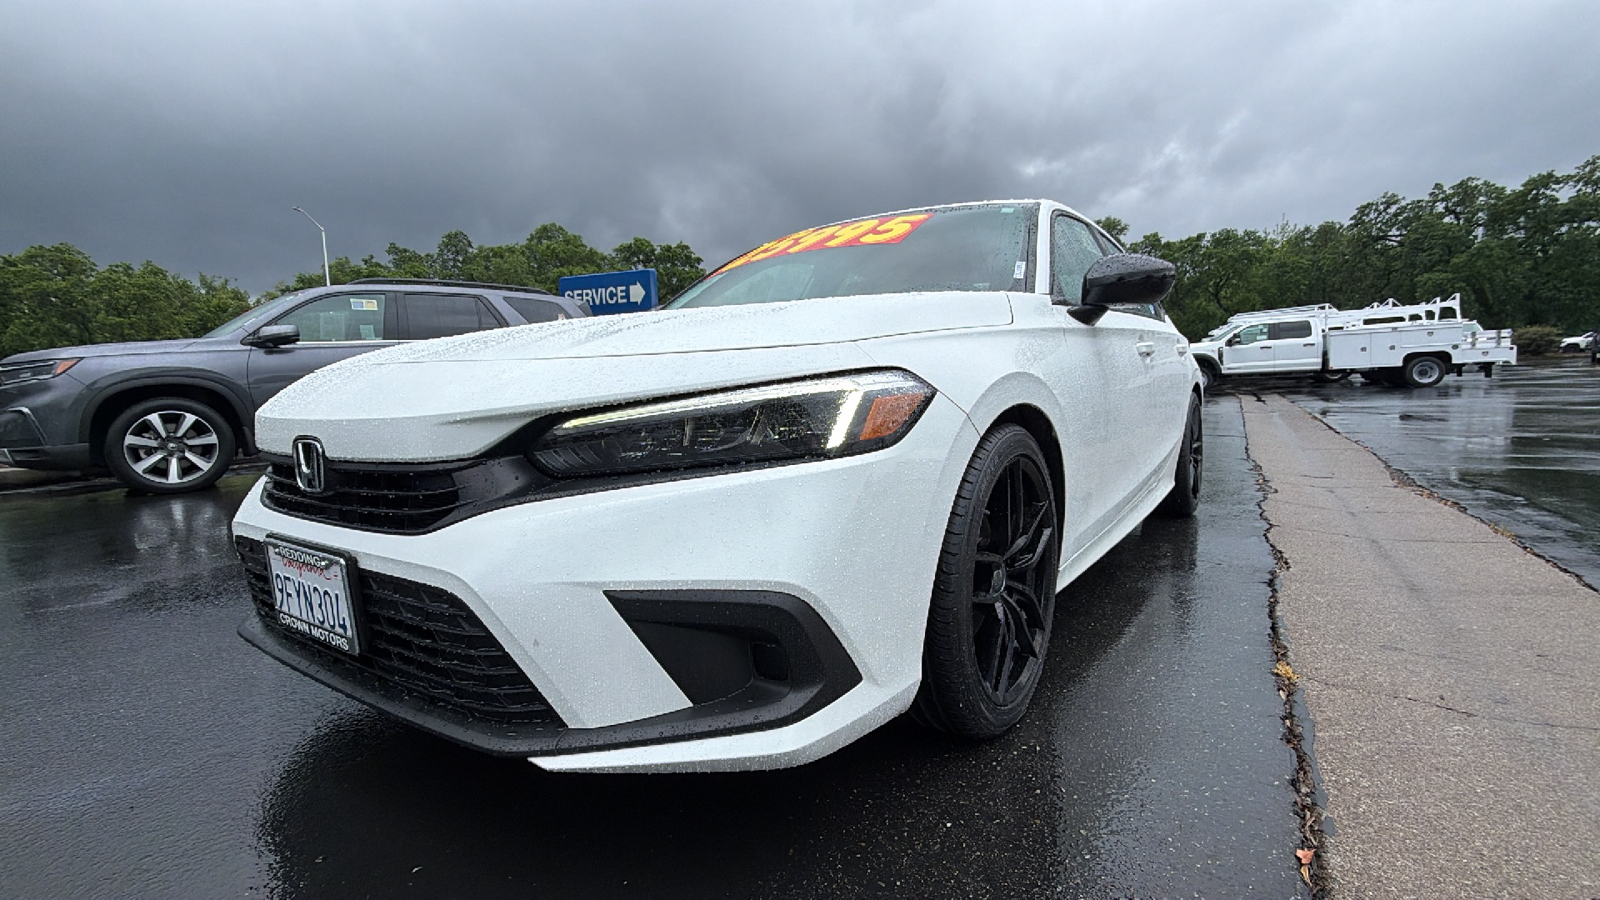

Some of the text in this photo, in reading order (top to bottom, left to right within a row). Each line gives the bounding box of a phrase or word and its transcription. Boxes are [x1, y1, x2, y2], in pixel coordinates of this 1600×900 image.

[279, 546, 321, 567] REDDING
[275, 572, 348, 636] 9FYN304
[279, 612, 349, 651] CROWN MOTORS
